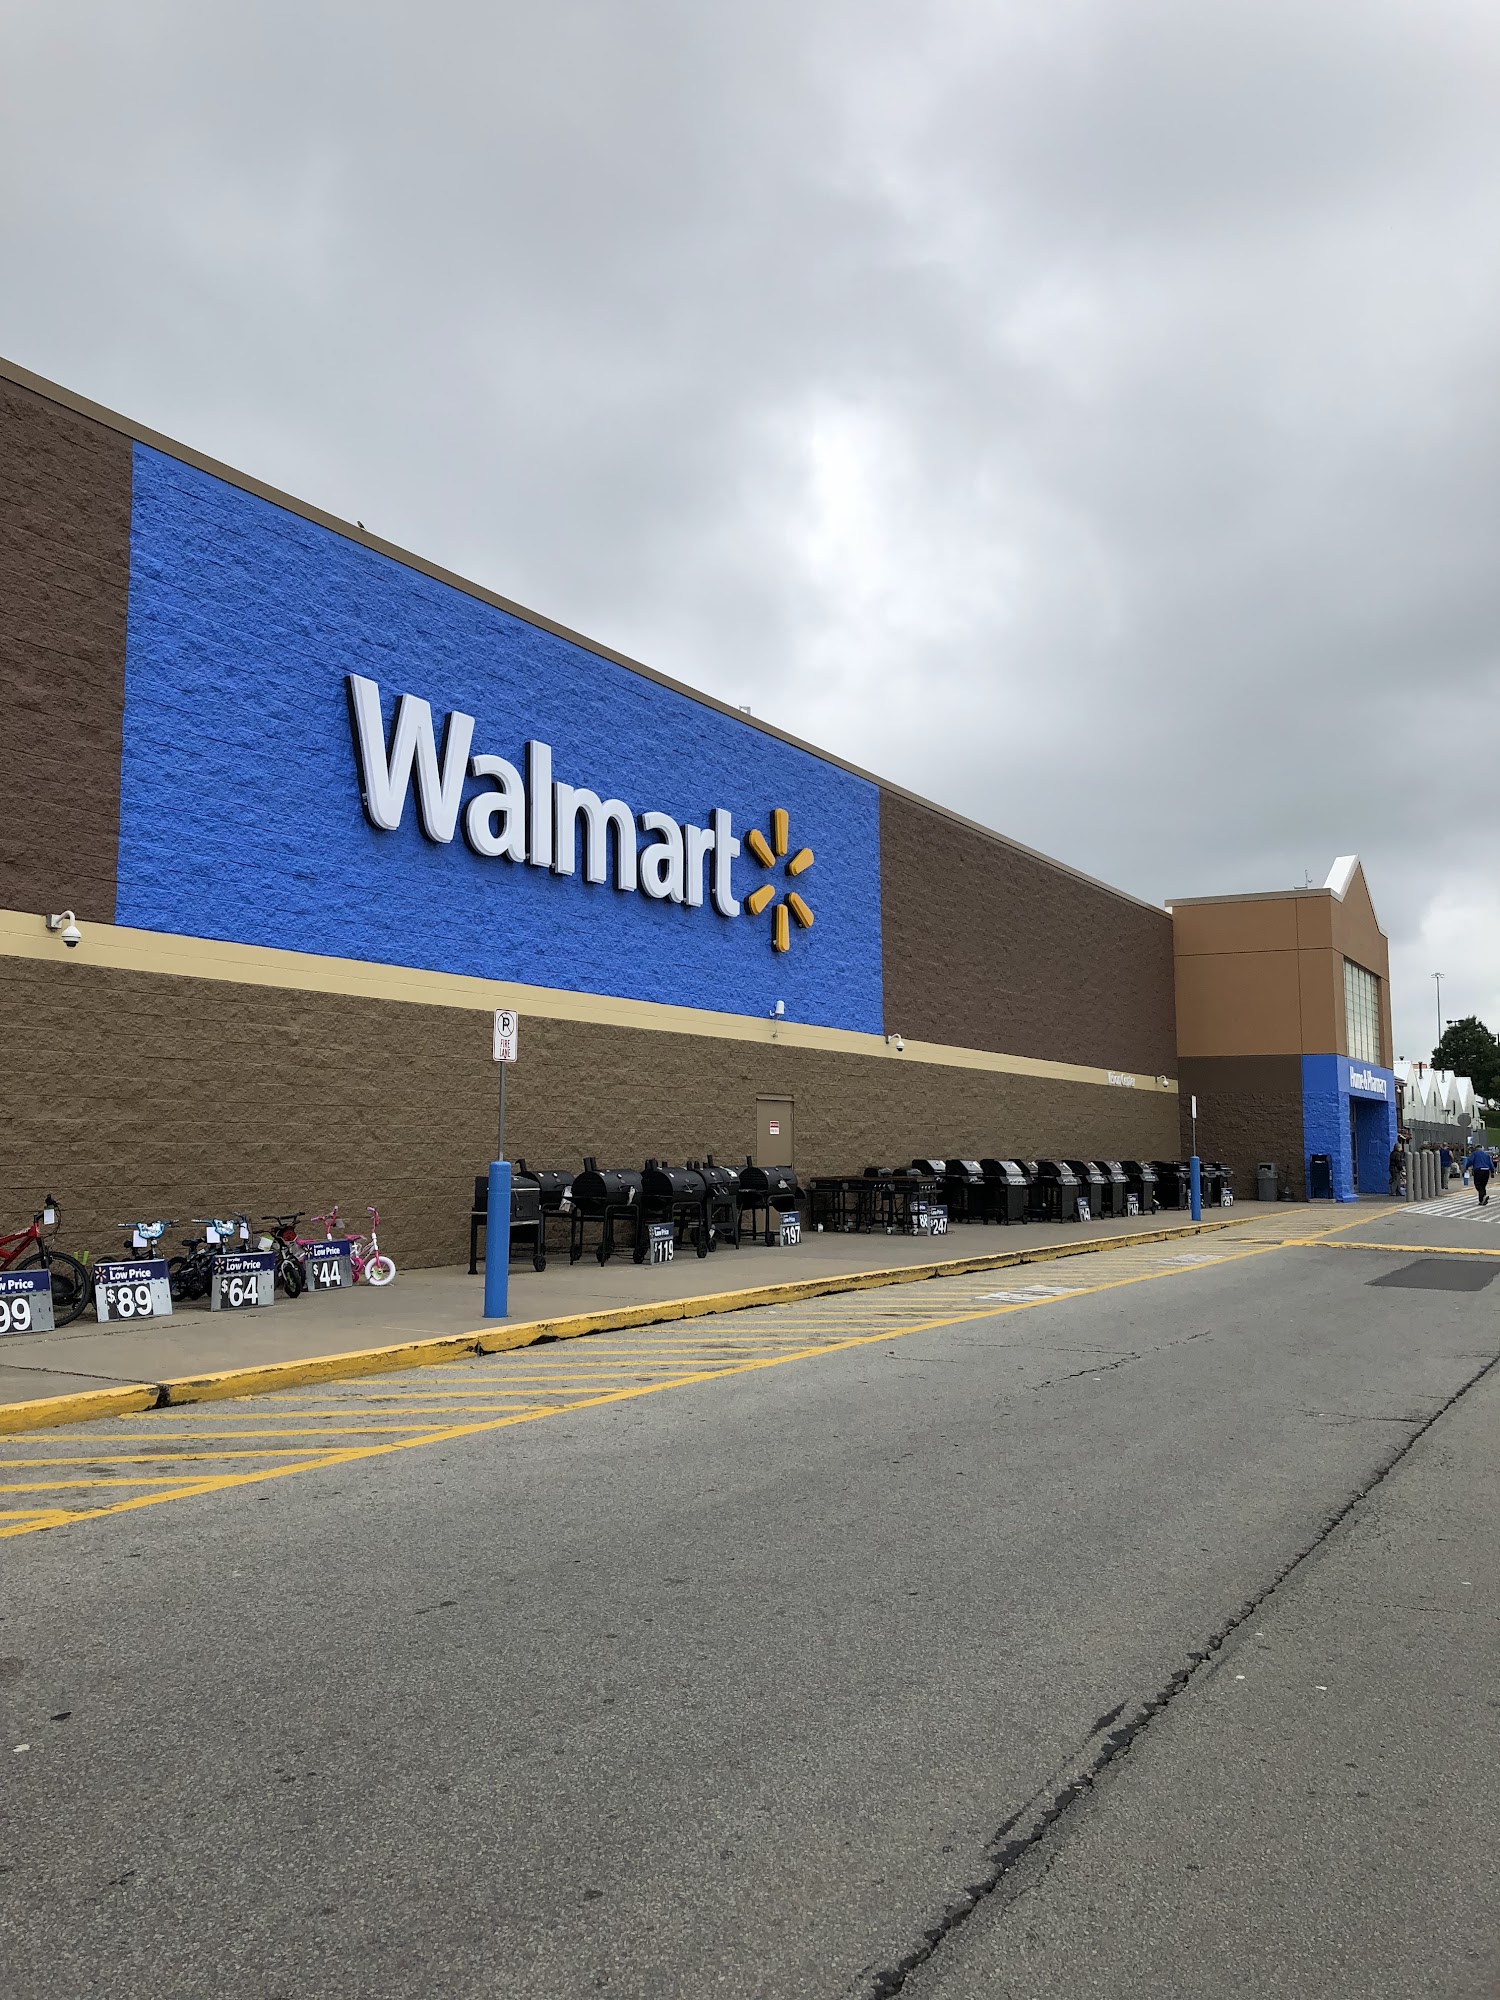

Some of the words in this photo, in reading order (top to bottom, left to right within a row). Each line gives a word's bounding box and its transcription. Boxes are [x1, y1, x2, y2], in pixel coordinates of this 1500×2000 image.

[347, 673, 741, 918] Walmart
[500, 1038, 511, 1048] FIRE
[499, 1048, 511, 1058] LANE
[1108, 1071, 1121, 1085] Vision
[1120, 1073, 1136, 1087] Center
[1349, 1065, 1363, 1090] Home
[1367, 1070, 1387, 1100] Pharmacy
[782, 1225, 801, 1245] $197
[930, 1217, 948, 1235] $247
[313, 1248, 326, 1257] Low
[325, 1246, 341, 1256] Price
[654, 1239, 674, 1262] $119
[109, 1270, 128, 1281] Low
[128, 1267, 151, 1279] Price
[226, 1259, 242, 1271] Low
[242, 1259, 261, 1270] Price
[312, 1260, 342, 1287] $44
[7, 1278, 34, 1290] Price
[221, 1276, 259, 1307] $64
[107, 1285, 153, 1318] $89
